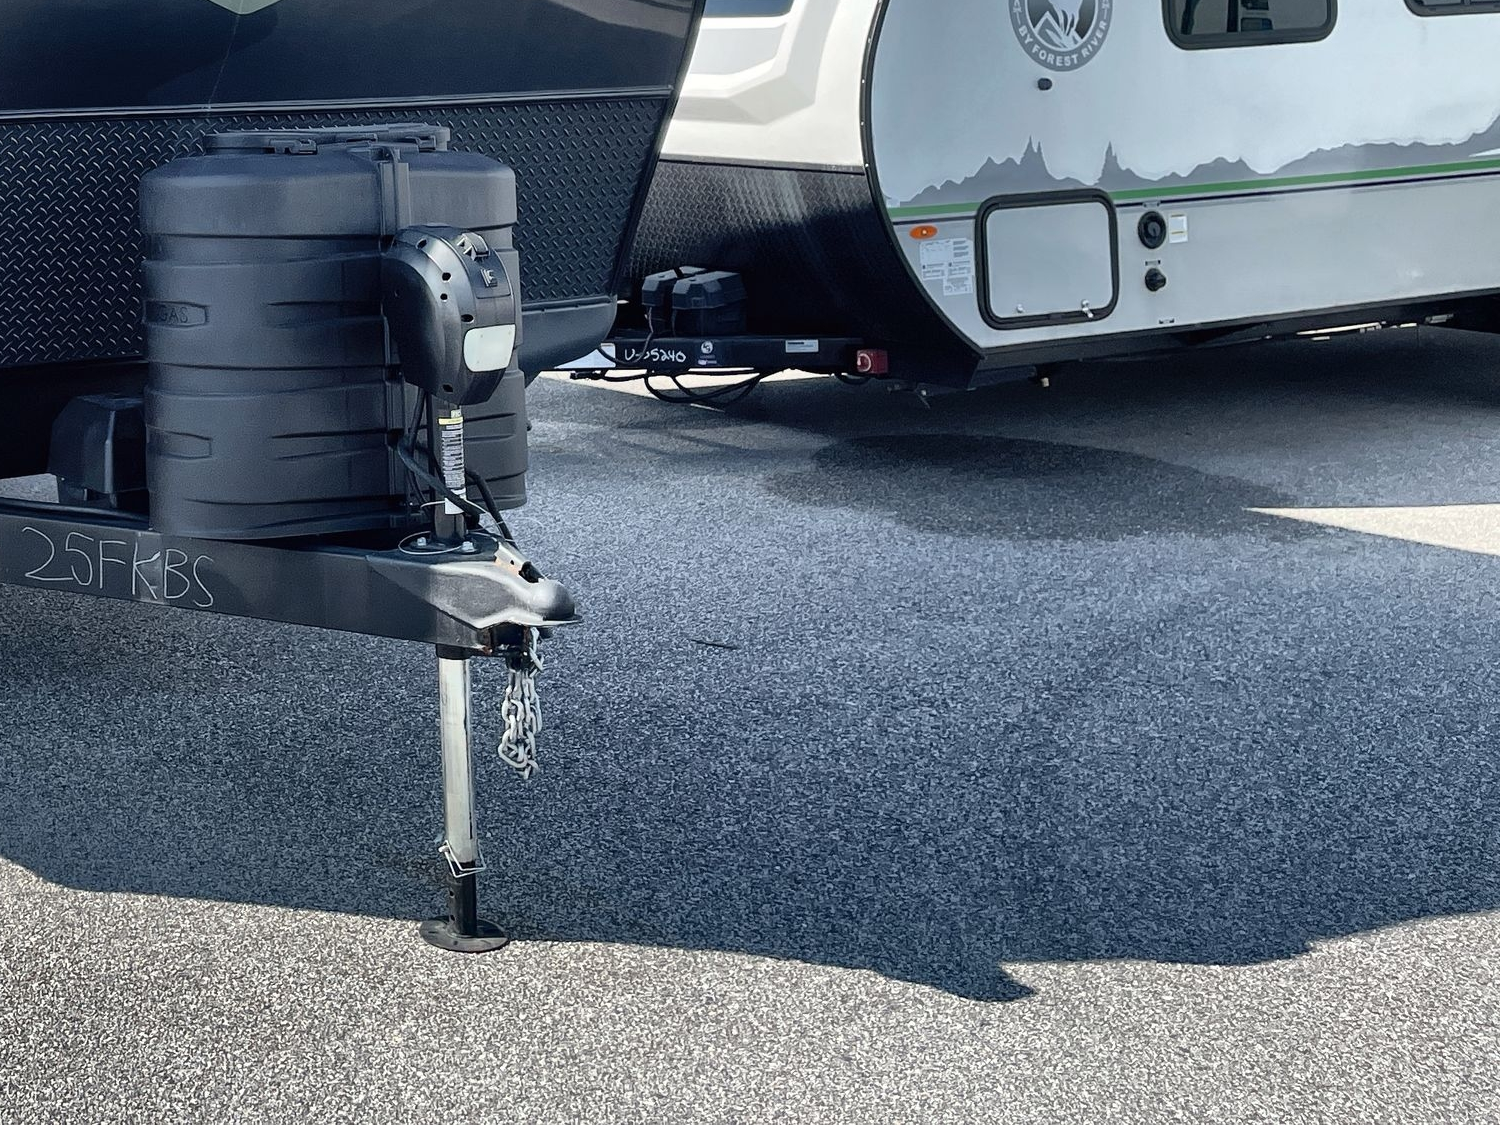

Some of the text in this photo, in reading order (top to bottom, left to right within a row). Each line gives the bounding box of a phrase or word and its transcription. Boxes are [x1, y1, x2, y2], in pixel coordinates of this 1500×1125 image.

[1018, 20, 1107, 67] BY FOREST RIVER
[21, 526, 214, 607] 25FKBS
